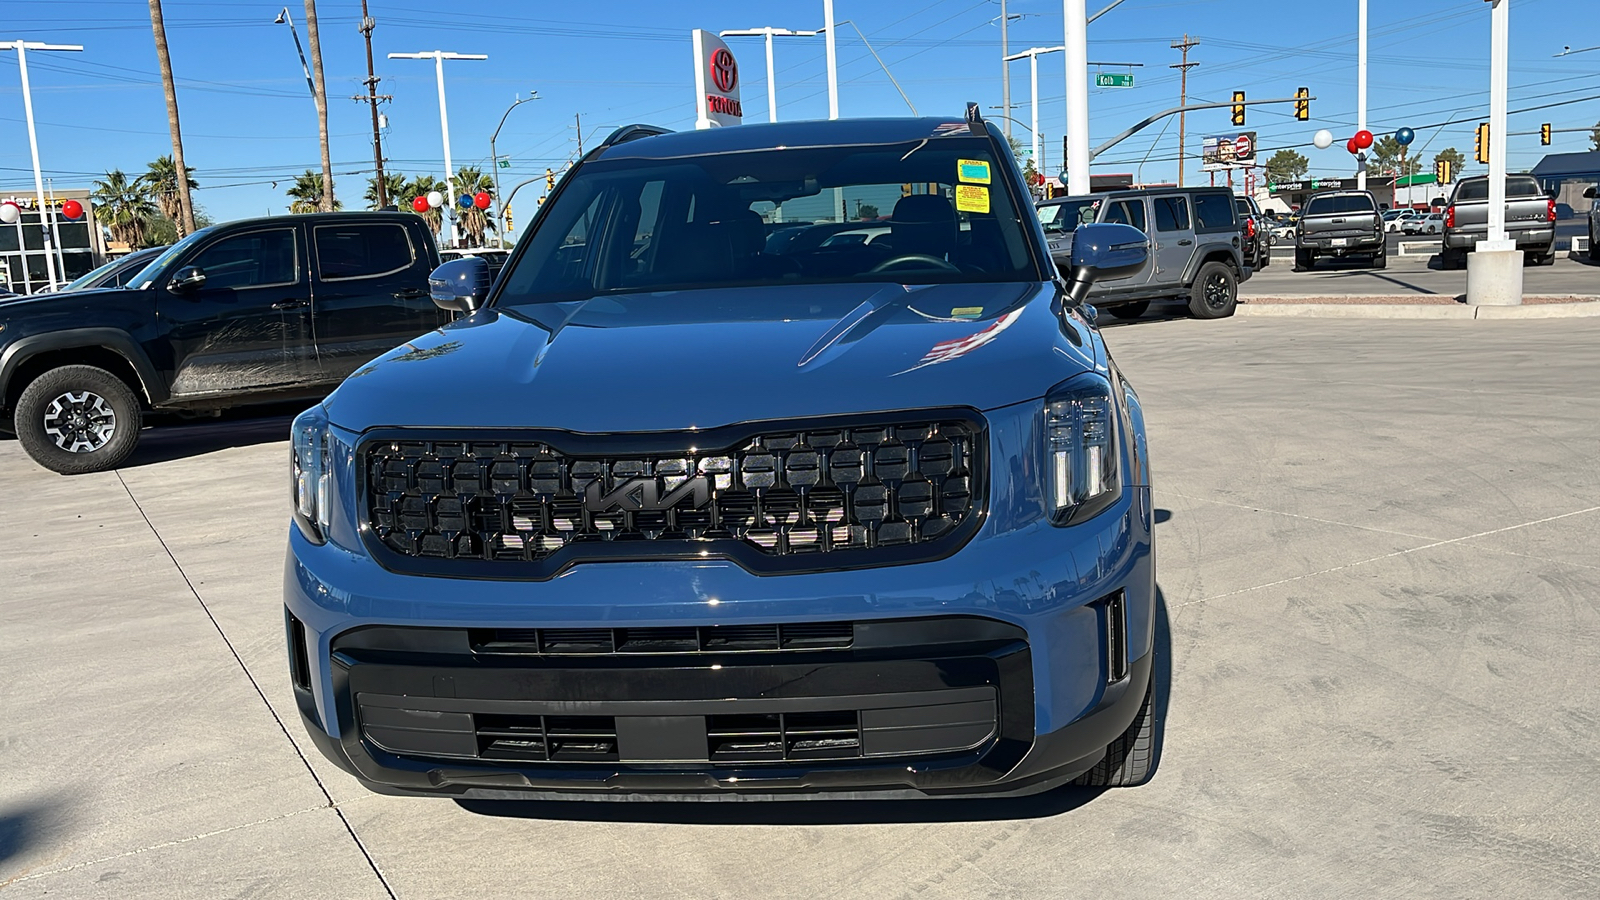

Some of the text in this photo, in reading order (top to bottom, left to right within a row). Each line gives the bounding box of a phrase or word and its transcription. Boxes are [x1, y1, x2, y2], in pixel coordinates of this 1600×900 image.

[1100, 75, 1114, 85] Kolb
[707, 94, 743, 117] TOYOTA
[1271, 183, 1303, 191] enterprise
[1313, 180, 1341, 188] enterprise
[585, 475, 709, 511] KIA
